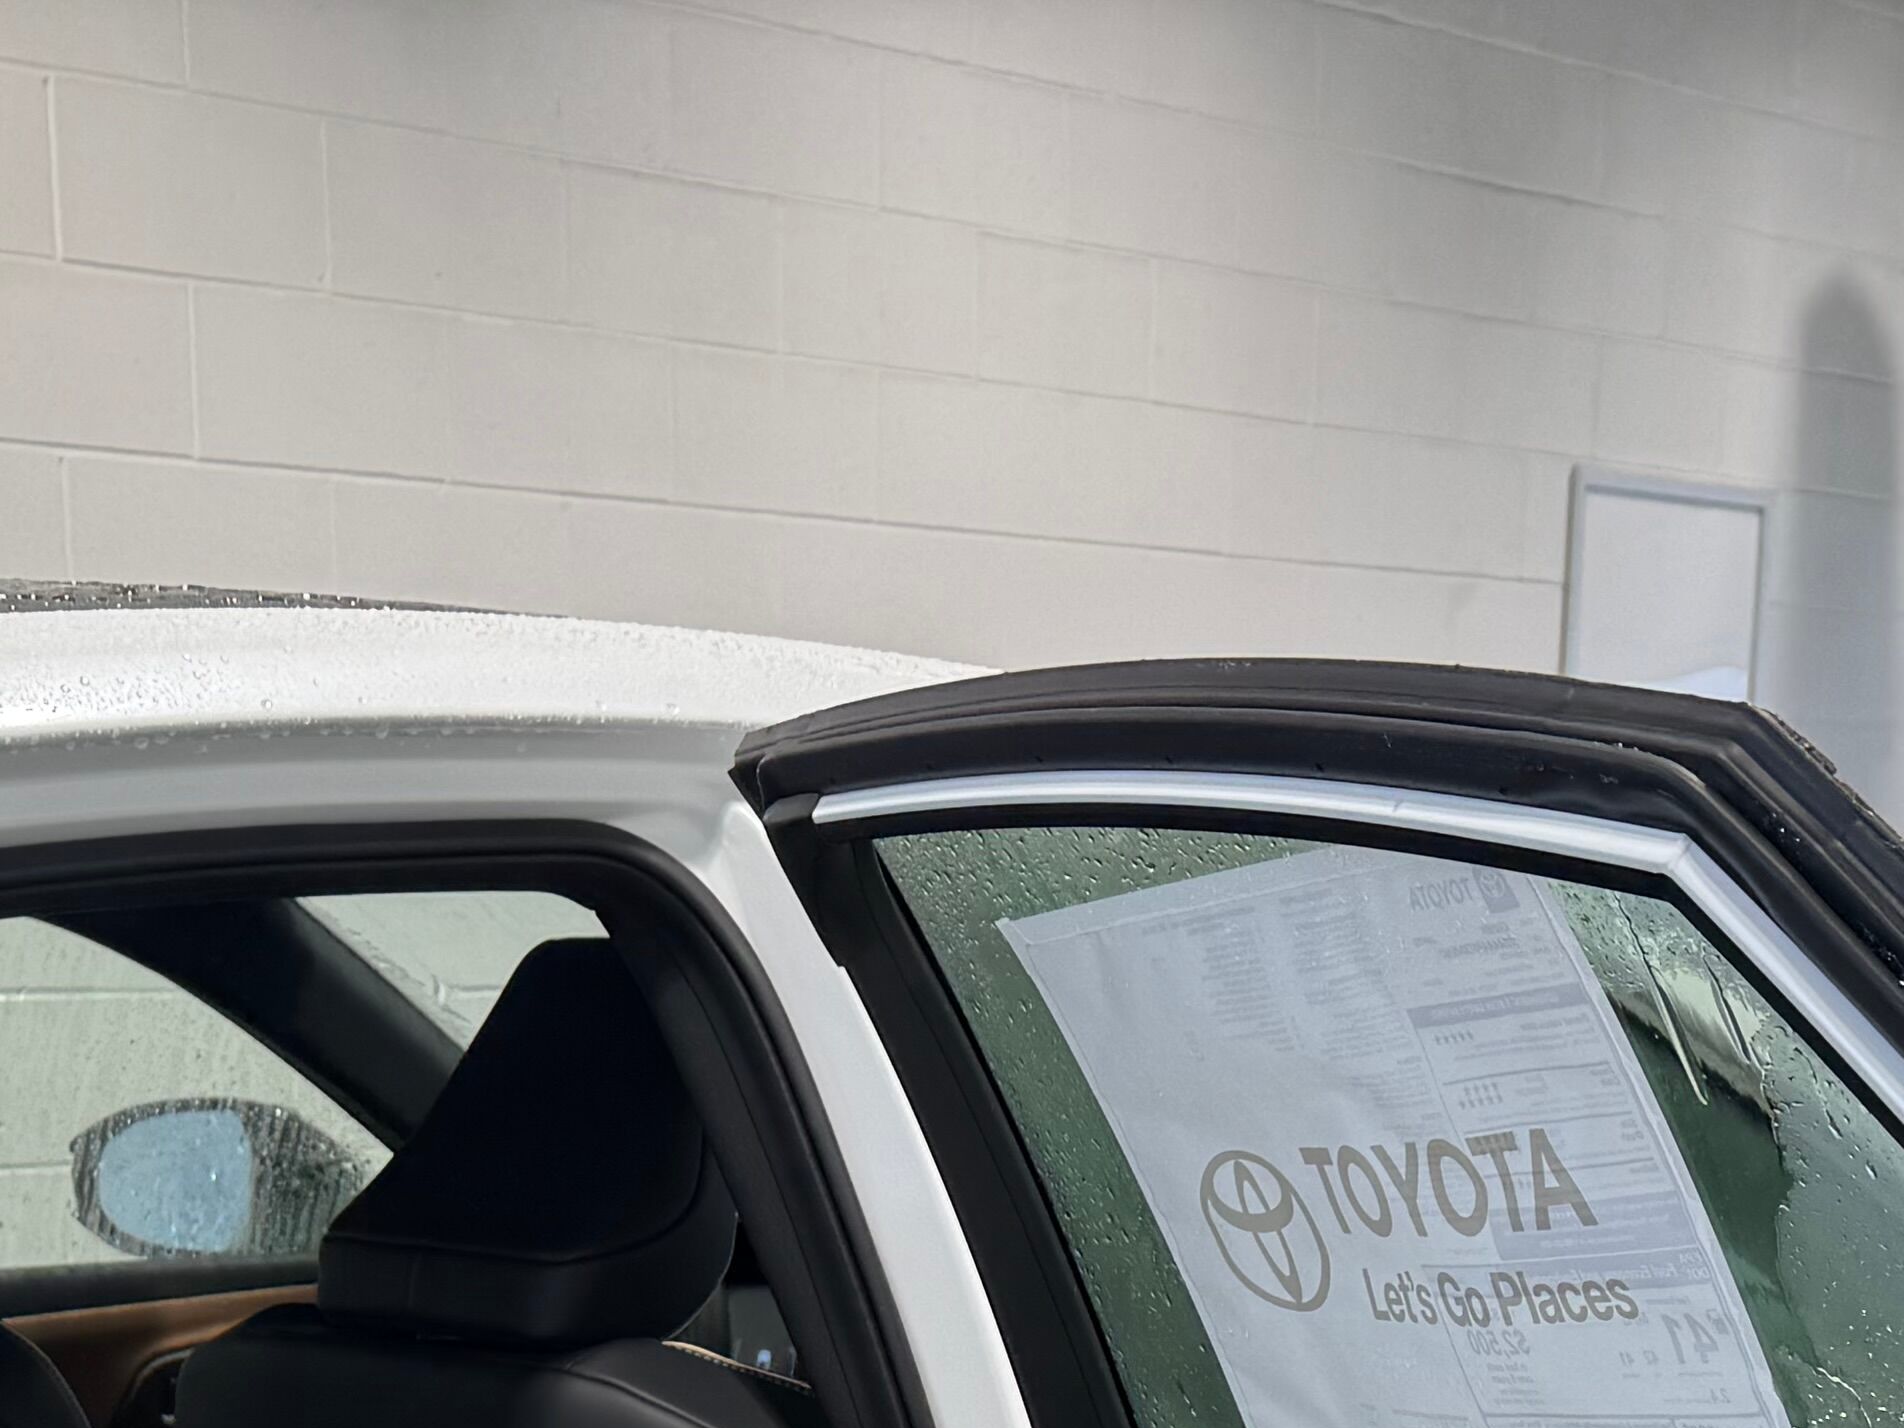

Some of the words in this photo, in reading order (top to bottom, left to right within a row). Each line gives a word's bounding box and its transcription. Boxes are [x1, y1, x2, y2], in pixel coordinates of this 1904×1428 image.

[1298, 1127, 1599, 1237] TOYOTA
[1363, 1267, 1437, 1326] Let's
[1437, 1271, 1490, 1328] Go
[1489, 1270, 1639, 1326] Places
